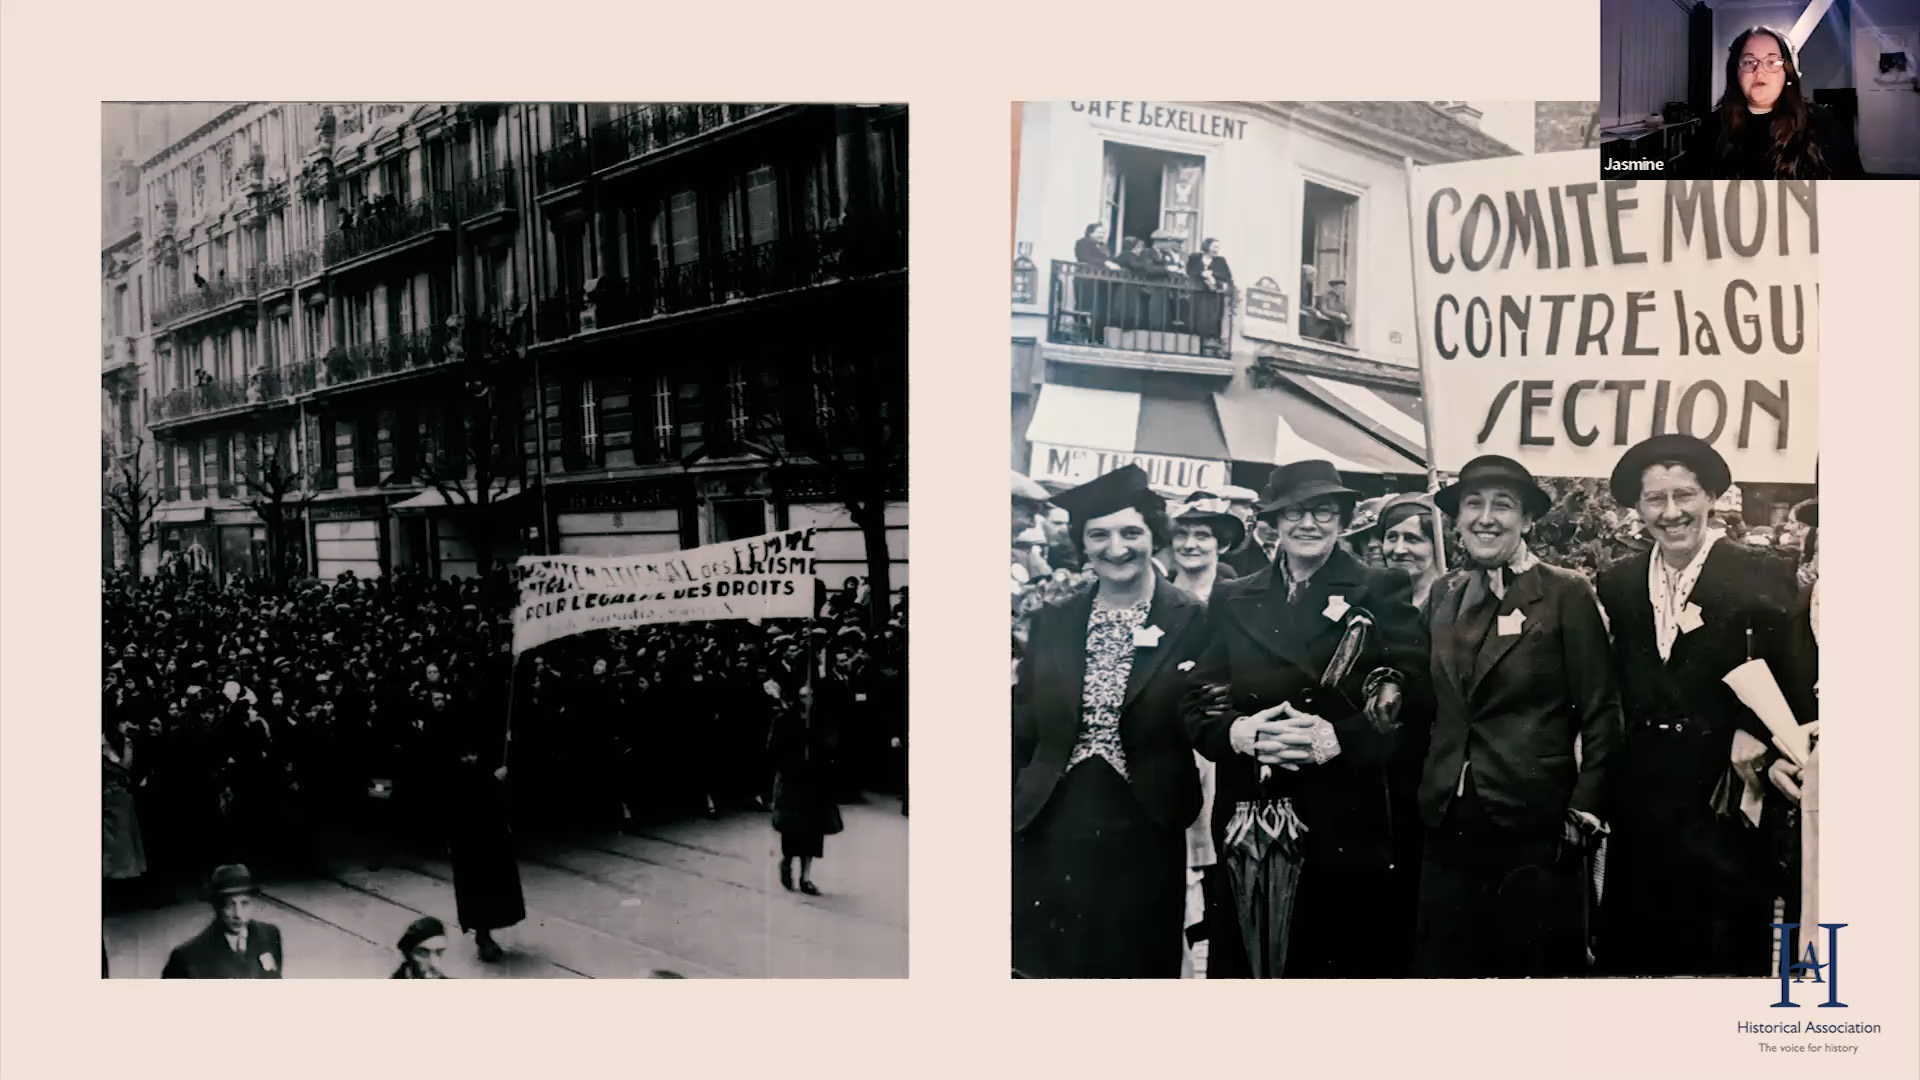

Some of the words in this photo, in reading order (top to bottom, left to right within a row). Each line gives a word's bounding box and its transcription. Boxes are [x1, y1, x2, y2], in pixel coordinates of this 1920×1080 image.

[1071, 101, 1133, 123] CAFE
[1427, 180, 1648, 274] COMITE
[1663, 180, 1820, 263] MON
[1434, 290, 1659, 360] CONTRE
[1674, 290, 1721, 356] la
[1724, 279, 1820, 355] GU
[1477, 379, 1789, 450] SECTION
[526, 598, 566, 620] POUR
[717, 580, 795, 597] DROITS
